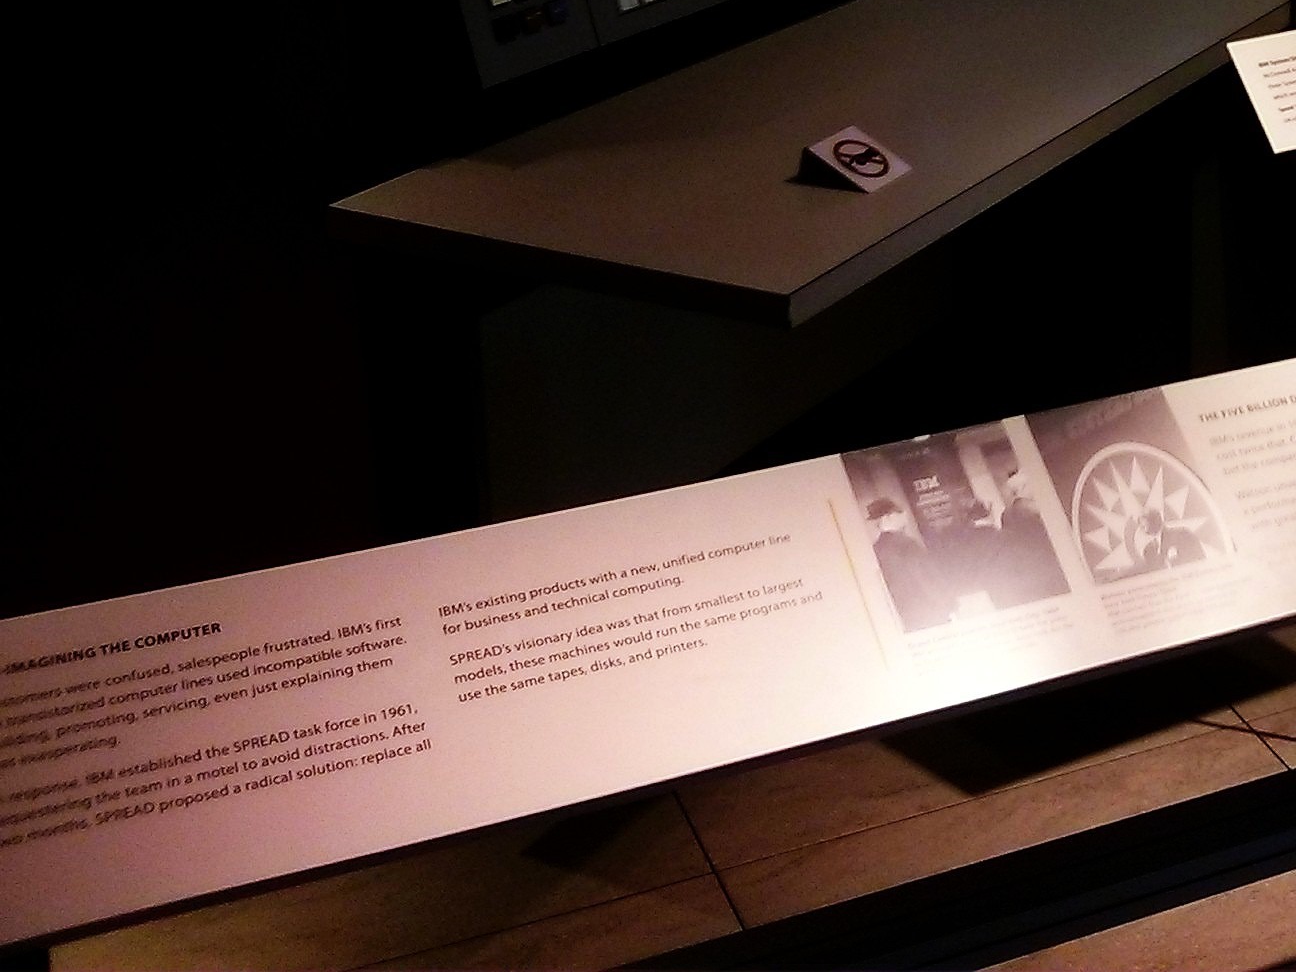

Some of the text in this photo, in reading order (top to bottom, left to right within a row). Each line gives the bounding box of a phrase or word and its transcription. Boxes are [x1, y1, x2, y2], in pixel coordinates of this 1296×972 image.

[1199, 412, 1219, 422] THE
[1220, 406, 1245, 419] FIVE
[1246, 397, 1288, 412] BILLION
[438, 602, 472, 617] IBM's
[475, 593, 526, 609] existing
[529, 579, 586, 599] products
[588, 571, 617, 584] with
[629, 564, 660, 575] new,
[662, 551, 705, 569] unified
[707, 540, 765, 559] computer
[768, 534, 791, 545] line
[442, 577, 684, 635] for business and technical computing.
[63, 681, 100, 693] were
[103, 664, 174, 686] confused,
[177, 646, 260, 671] salespeople
[262, 630, 335, 654] frustrated.
[337, 624, 371, 638] IBM's
[374, 618, 402, 630] first
[99, 640, 131, 656] THE
[133, 623, 221, 648] COMPUTER
[449, 578, 804, 665] SPREAD's visionary idea was that from smallest to largest
[453, 591, 824, 684] models, these machines would run the same programs and
[55, 658, 393, 739] promoting, servicing, even just explaining them
[108, 683, 178, 705] computer
[180, 677, 213, 689] lines
[216, 666, 250, 682] used
[252, 649, 342, 675] incompatible
[345, 636, 408, 655] software.
[457, 639, 708, 702] use the same tapes, disks, and printers.
[94, 791, 121, 803] the
[123, 782, 162, 797] team
[165, 778, 182, 787] in
[184, 775, 193, 784] a
[196, 762, 239, 780] motel
[241, 761, 258, 771] to
[261, 748, 300, 766] avoid
[303, 732, 389, 757] distractions.
[391, 722, 426, 737] After
[116, 749, 202, 777] established
[204, 746, 230, 759] the
[232, 731, 290, 752] SPREAD
[292, 724, 321, 739] task
[324, 718, 360, 732] force
[363, 714, 377, 724] in
[380, 704, 418, 719] 1961,
[94, 802, 155, 825] SPREAD
[159, 784, 229, 813] proposed
[232, 785, 241, 794] a
[245, 771, 293, 790] radical
[295, 759, 358, 780] solution:
[360, 747, 412, 764] replace
[415, 739, 432, 752] all
